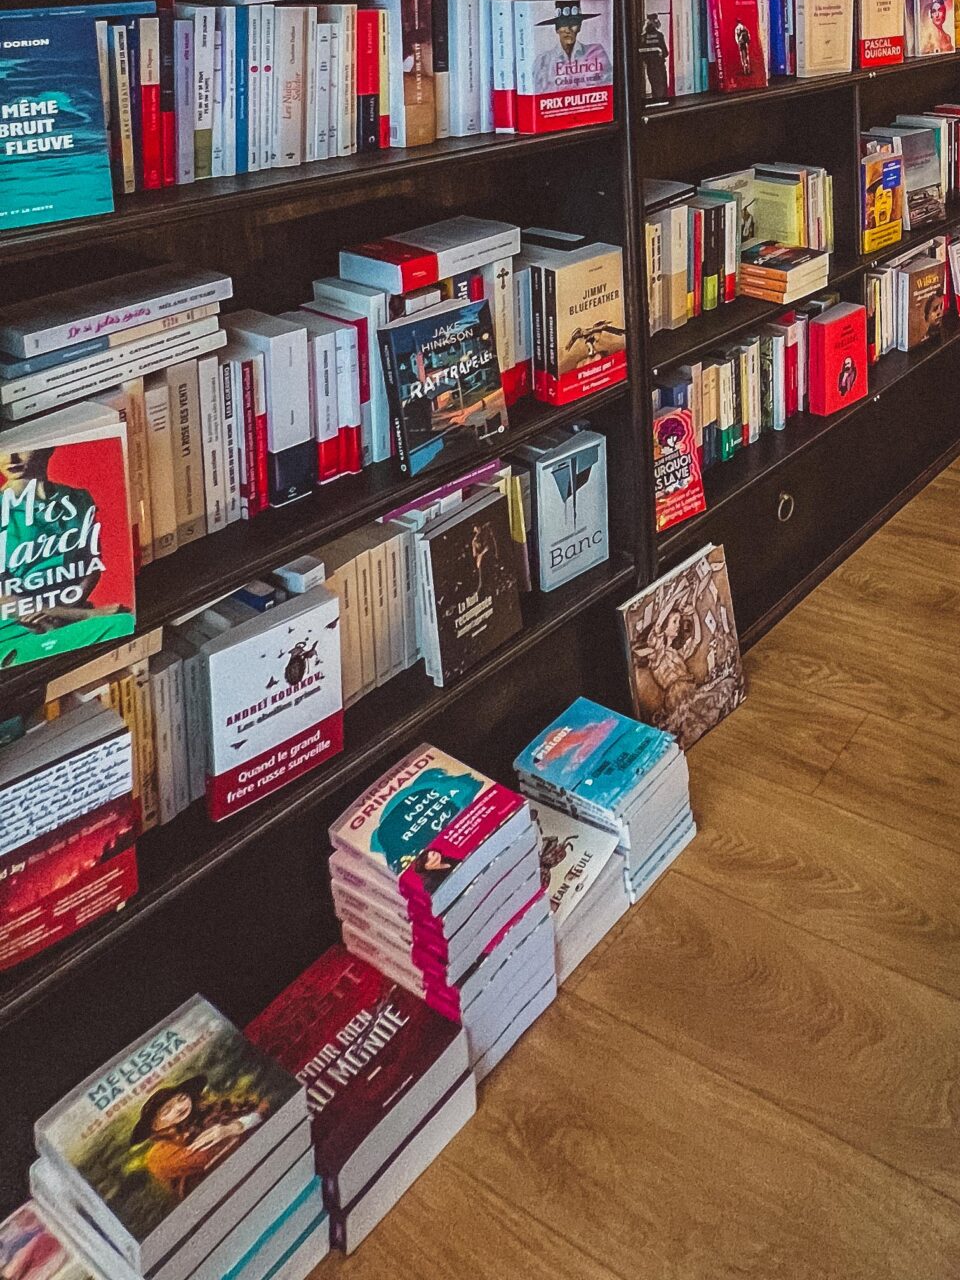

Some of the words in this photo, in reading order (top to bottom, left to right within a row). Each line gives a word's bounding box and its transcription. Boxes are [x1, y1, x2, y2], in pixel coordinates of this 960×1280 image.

[3, 38, 50, 48] DORION
[864, 39, 891, 49] PASCAL
[864, 46, 900, 59] QUIGNARD
[556, 56, 604, 76] Erdrich
[1, 99, 59, 119] MÊME
[540, 97, 564, 110] PRIX
[564, 91, 608, 107] PULITZER
[0, 119, 55, 138] BRUIT
[5, 134, 75, 156] FLEUVE
[582, 283, 607, 300] JIMMY
[569, 290, 620, 316] BLUEFEATHER
[421, 328, 474, 353] HINKSON
[431, 321, 461, 339] JAKE
[178, 383, 188, 407] VENTS
[180, 408, 189, 424] DES
[181, 425, 190, 445] ROSE
[182, 446, 191, 458] LA
[675, 465, 690, 480] VIE
[0, 505, 101, 575] arch
[549, 529, 603, 569] Banc
[0, 585, 84, 622] FEITO
[226, 697, 269, 727] ANDREÏ
[271, 672, 322, 705] KOURKOV
[236, 720, 255, 734] Les
[238, 754, 276, 783] Quand
[277, 750, 288, 763] le
[290, 730, 321, 757] grand
[227, 784, 254, 804] frère
[257, 767, 286, 788] russe
[288, 738, 331, 772] surveille
[350, 753, 435, 830] GRIMALDI
[404, 794, 419, 805] IL
[401, 789, 460, 841] RESTERA
[337, 1008, 374, 1047] RIEN
[334, 1003, 410, 1086] MONDE
[93, 1086, 124, 1111] DA
[127, 1038, 187, 1086] COSTA
